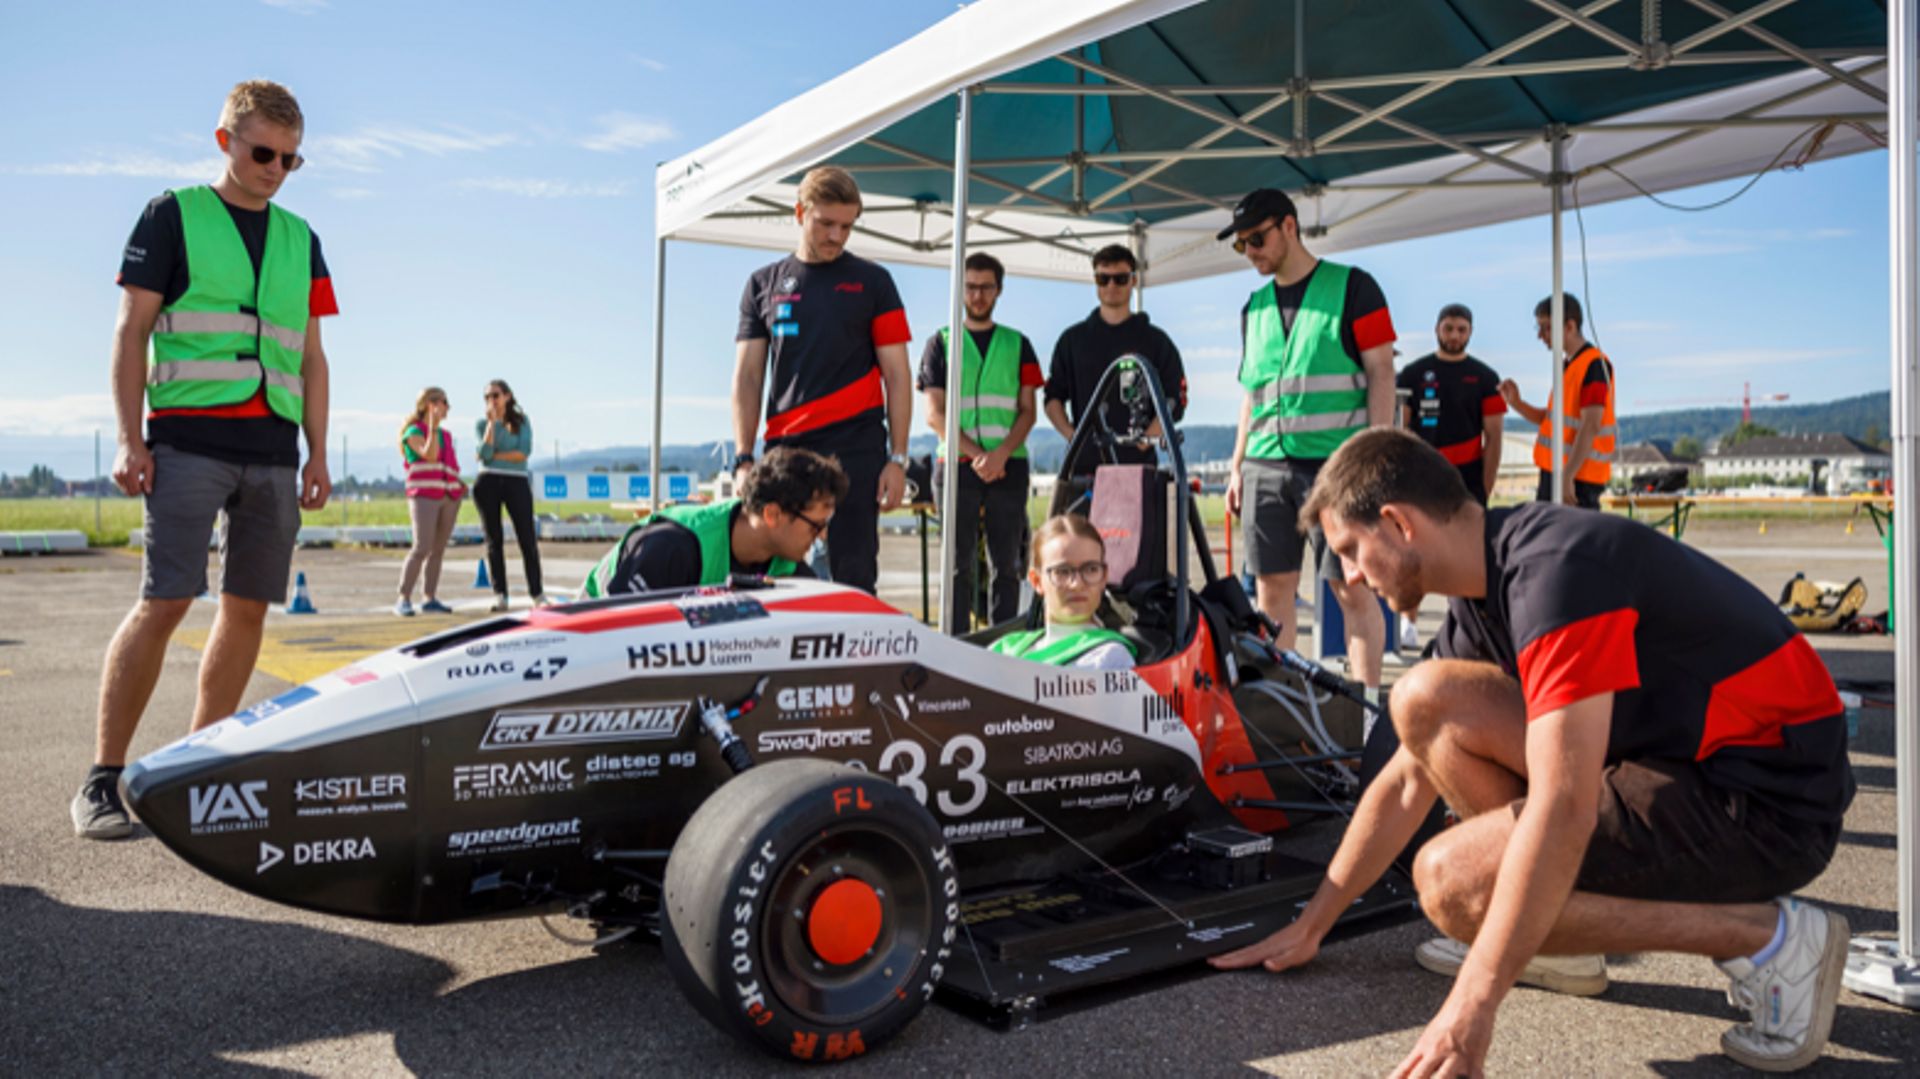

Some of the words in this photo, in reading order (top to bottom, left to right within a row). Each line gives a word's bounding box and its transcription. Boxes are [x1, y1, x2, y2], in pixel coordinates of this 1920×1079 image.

[627, 641, 706, 670] HSLU
[709, 637, 781, 652] Hochschule
[709, 651, 753, 666] Luzern
[790, 633, 845, 661] ETH
[846, 630, 919, 659] zürich
[447, 660, 515, 680] RUAG
[777, 684, 855, 712] GENU
[1034, 674, 1097, 703] Julius
[1104, 671, 1142, 694] Bär
[918, 696, 972, 714] Vincotech
[554, 706, 681, 734] DYNAMIX
[984, 715, 1055, 736] autobau
[493, 726, 534, 743] CNC
[758, 728, 872, 754] Swaytronic
[586, 753, 661, 772] distec
[668, 751, 697, 768] ag
[1023, 741, 1097, 766] SIBATRON
[1100, 737, 1124, 757] AG
[294, 774, 406, 800] KISTLER
[453, 757, 575, 789] FERAMIC
[879, 734, 987, 817] 33
[1006, 768, 1142, 795] ELEKTRISOLA
[188, 780, 269, 825] VAC
[832, 785, 874, 816] FL
[447, 817, 581, 851] speedgoat
[293, 836, 377, 866] DEKRA
[731, 839, 777, 1011] Hoosier
